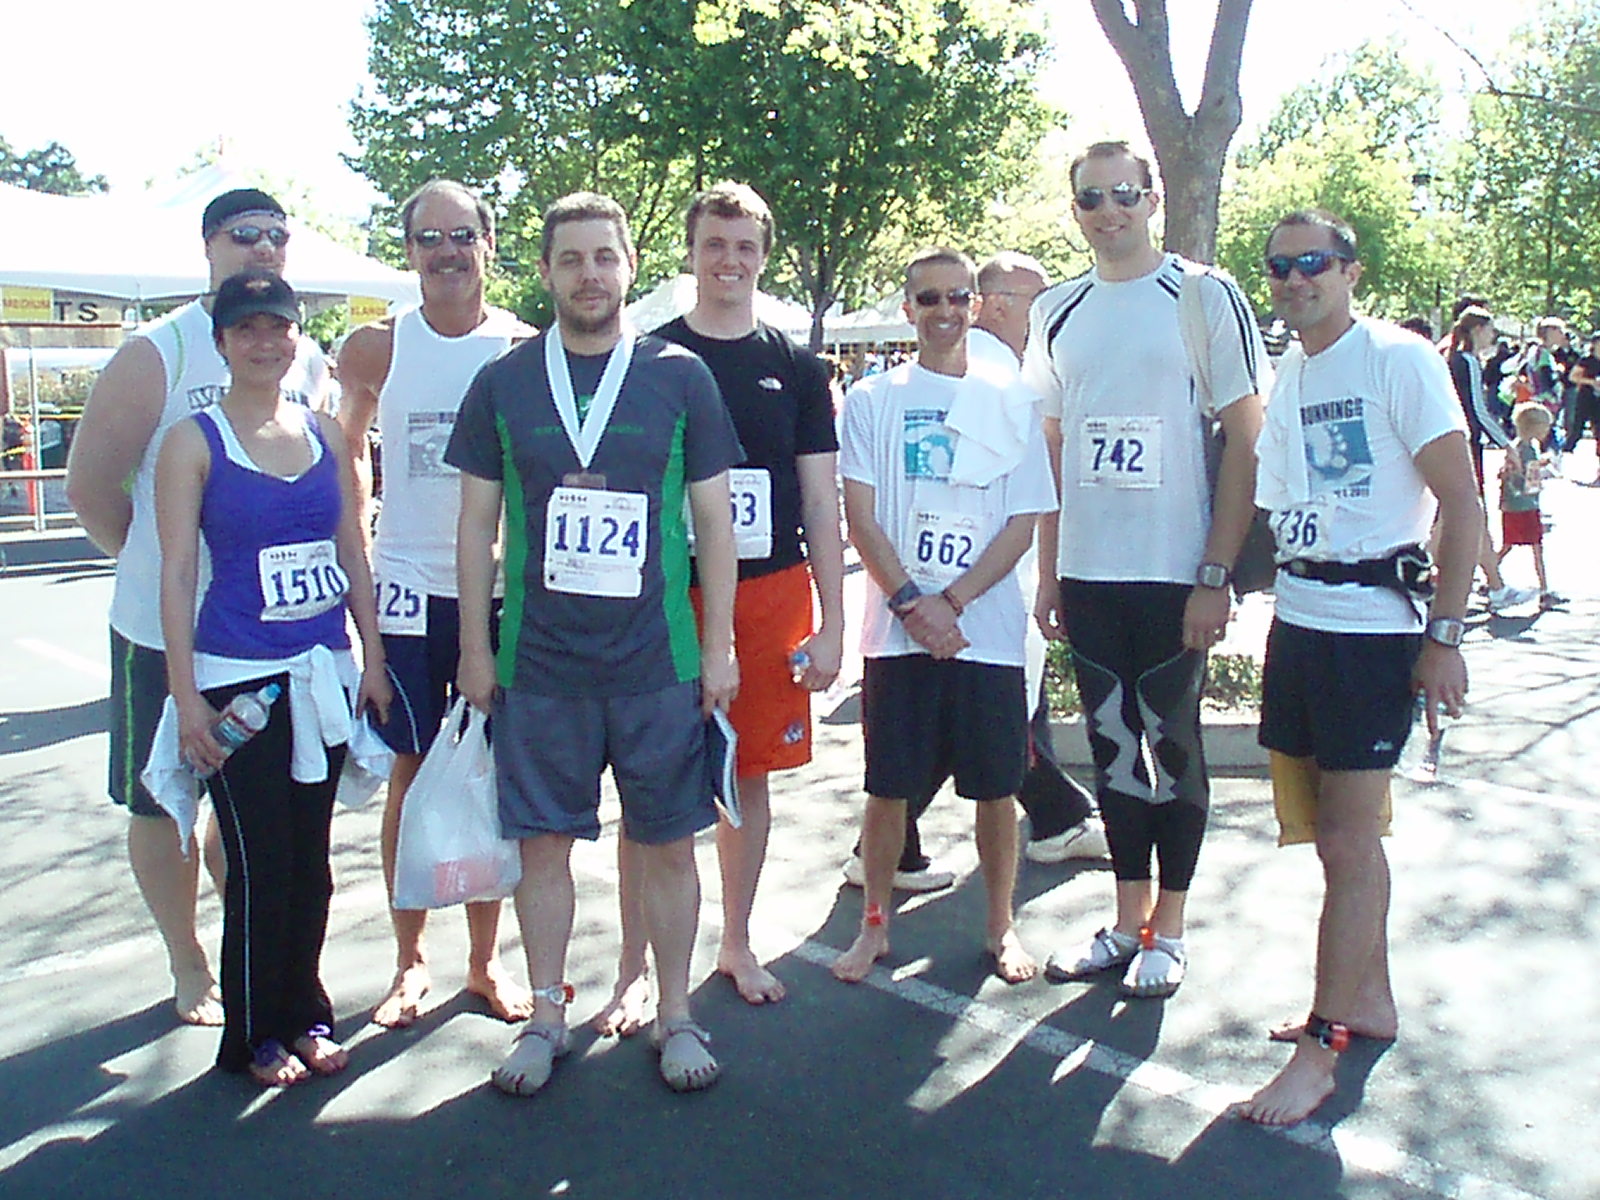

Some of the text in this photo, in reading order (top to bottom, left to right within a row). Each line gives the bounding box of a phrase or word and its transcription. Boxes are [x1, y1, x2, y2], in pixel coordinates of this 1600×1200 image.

[1092, 438, 1144, 472] 742
[554, 513, 640, 557] 1124
[1278, 510, 1319, 547] 736
[917, 530, 972, 568] 662
[271, 564, 345, 607] 1510
